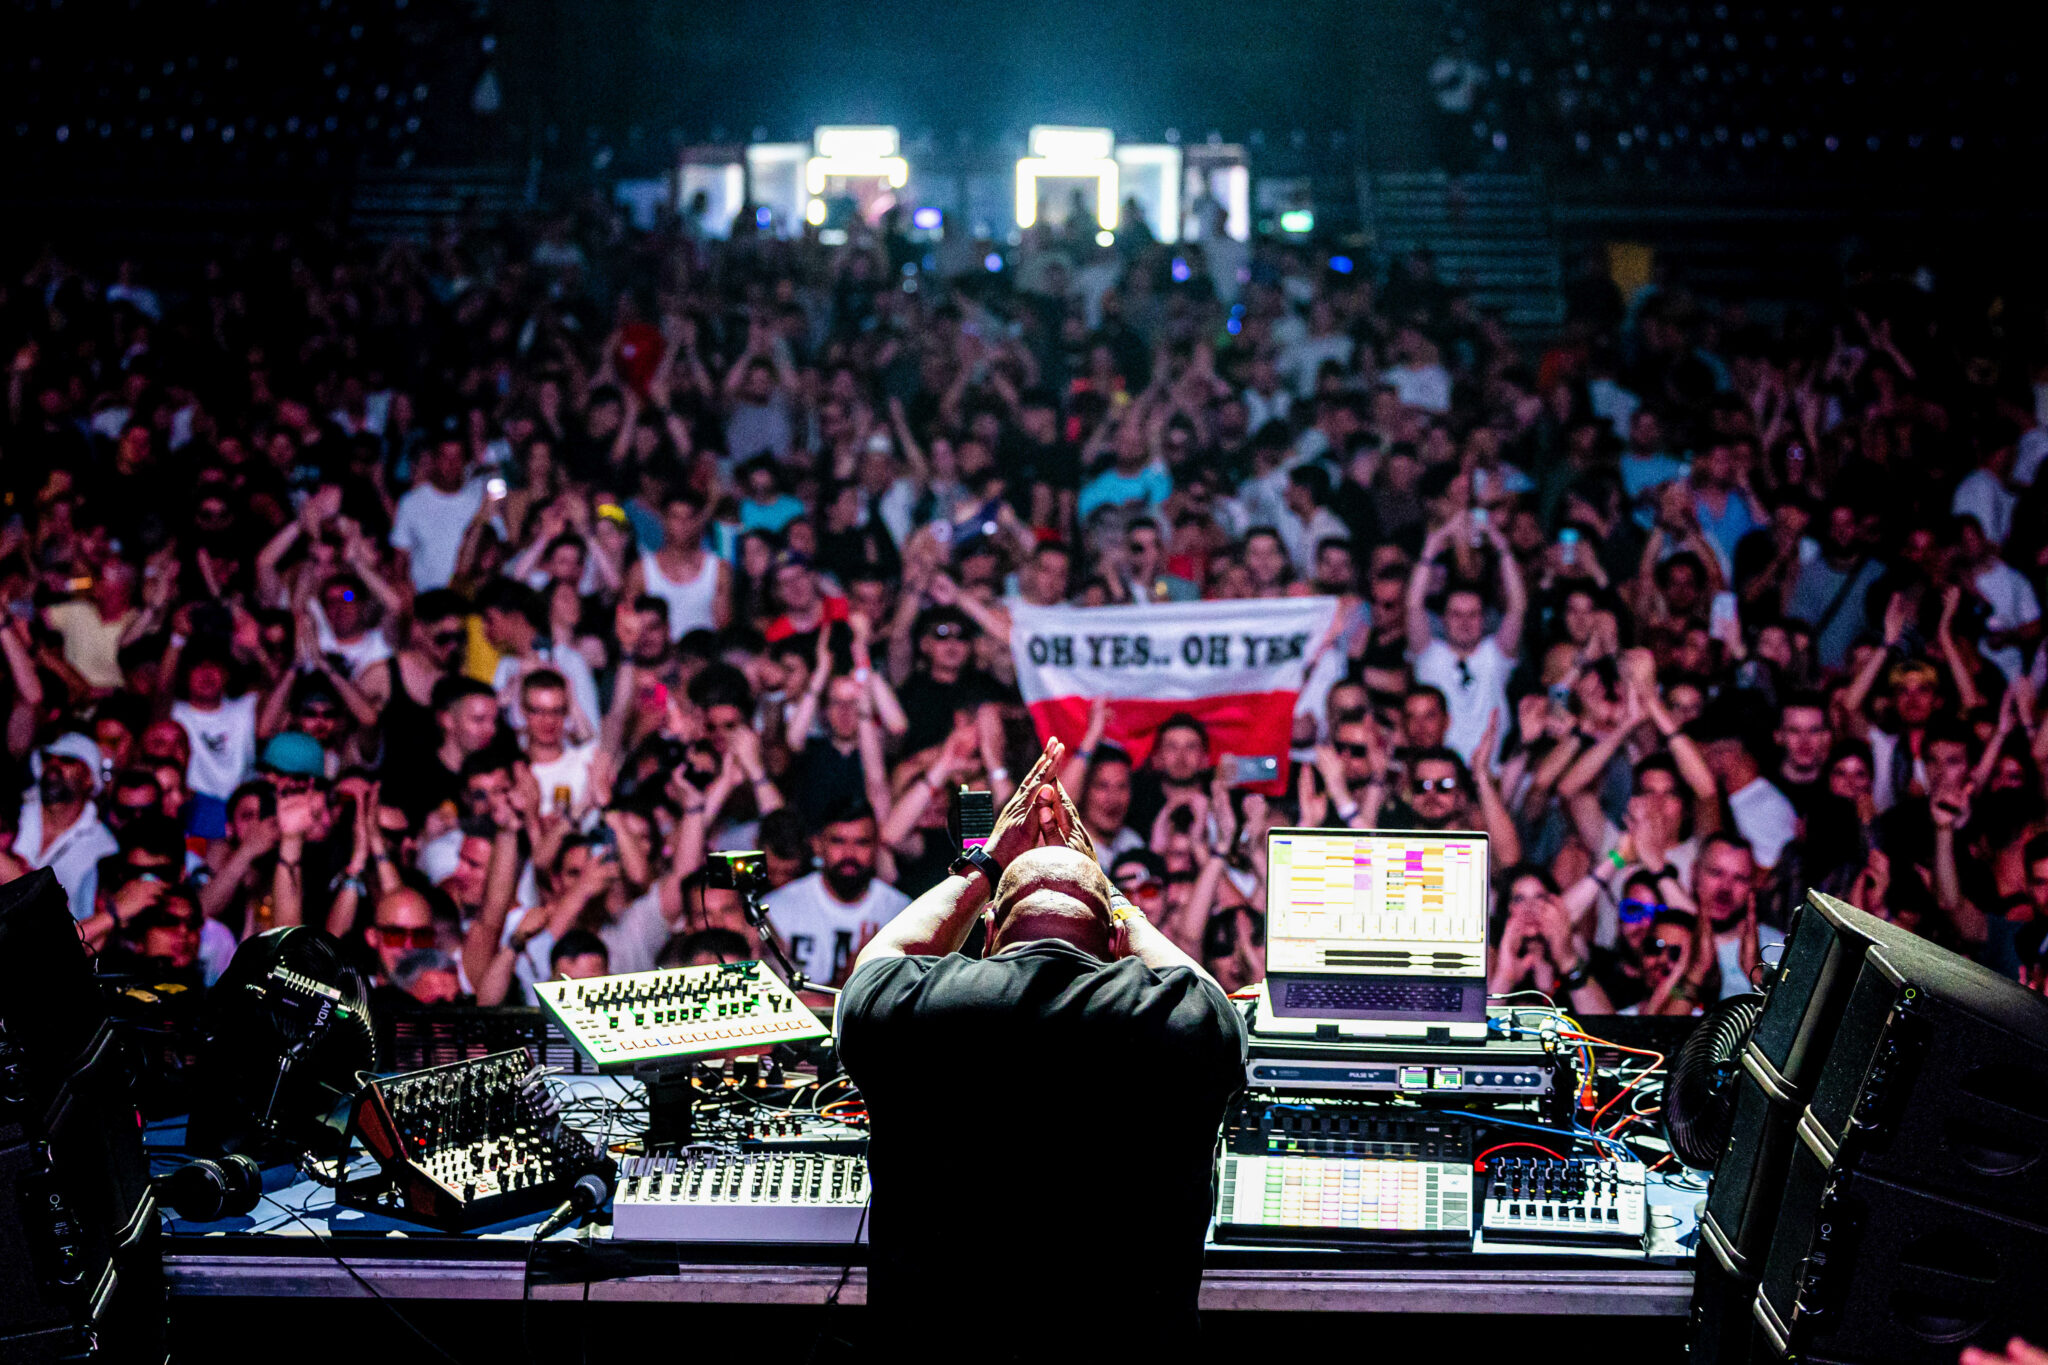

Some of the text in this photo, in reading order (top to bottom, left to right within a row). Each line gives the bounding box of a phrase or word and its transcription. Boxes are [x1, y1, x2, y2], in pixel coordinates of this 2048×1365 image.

[1028, 632, 1309, 667] OH YES.. OH YES
[315, 1000, 332, 1026] AIDA
